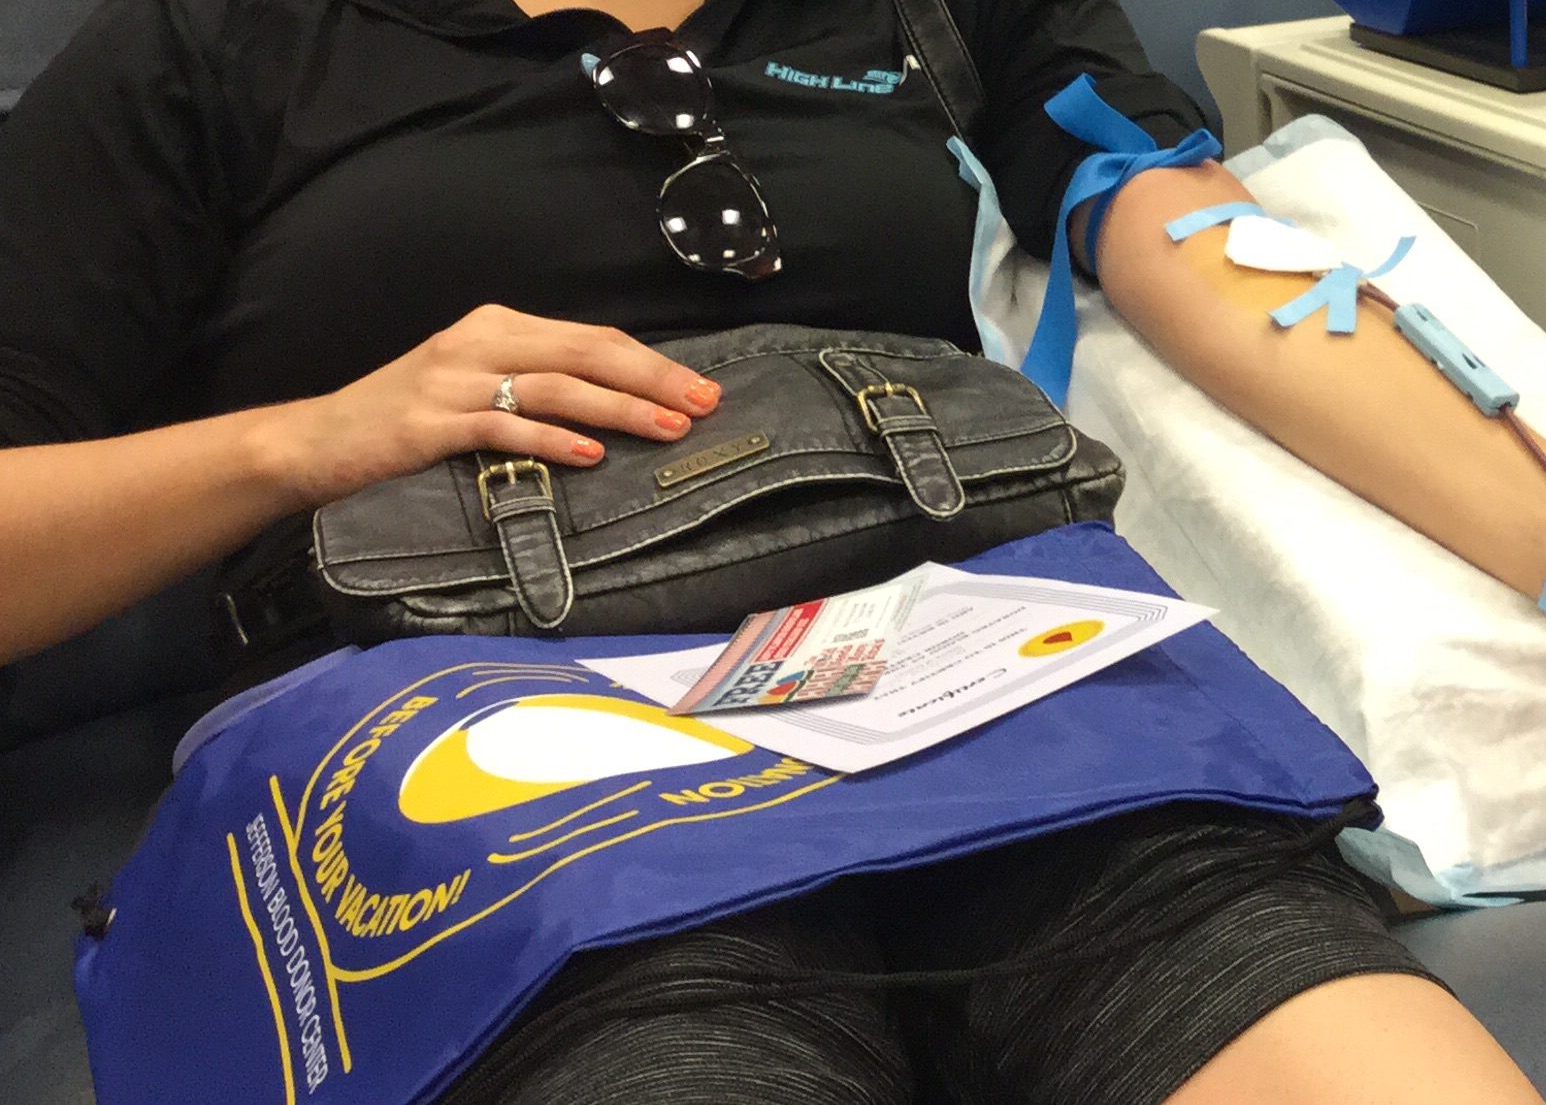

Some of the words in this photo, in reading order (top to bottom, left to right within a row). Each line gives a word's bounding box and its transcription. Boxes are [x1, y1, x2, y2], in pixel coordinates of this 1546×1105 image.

[763, 60, 830, 89] HIGH
[711, 659, 786, 707] FREE
[319, 695, 440, 811] BEFORE
[245, 812, 280, 902] JEFFERSON
[311, 800, 350, 904] YOUR
[267, 887, 299, 957] BLOOD
[334, 868, 472, 938] VACATION!
[286, 945, 317, 1027] DONOR
[301, 1014, 329, 1095] CENTER
